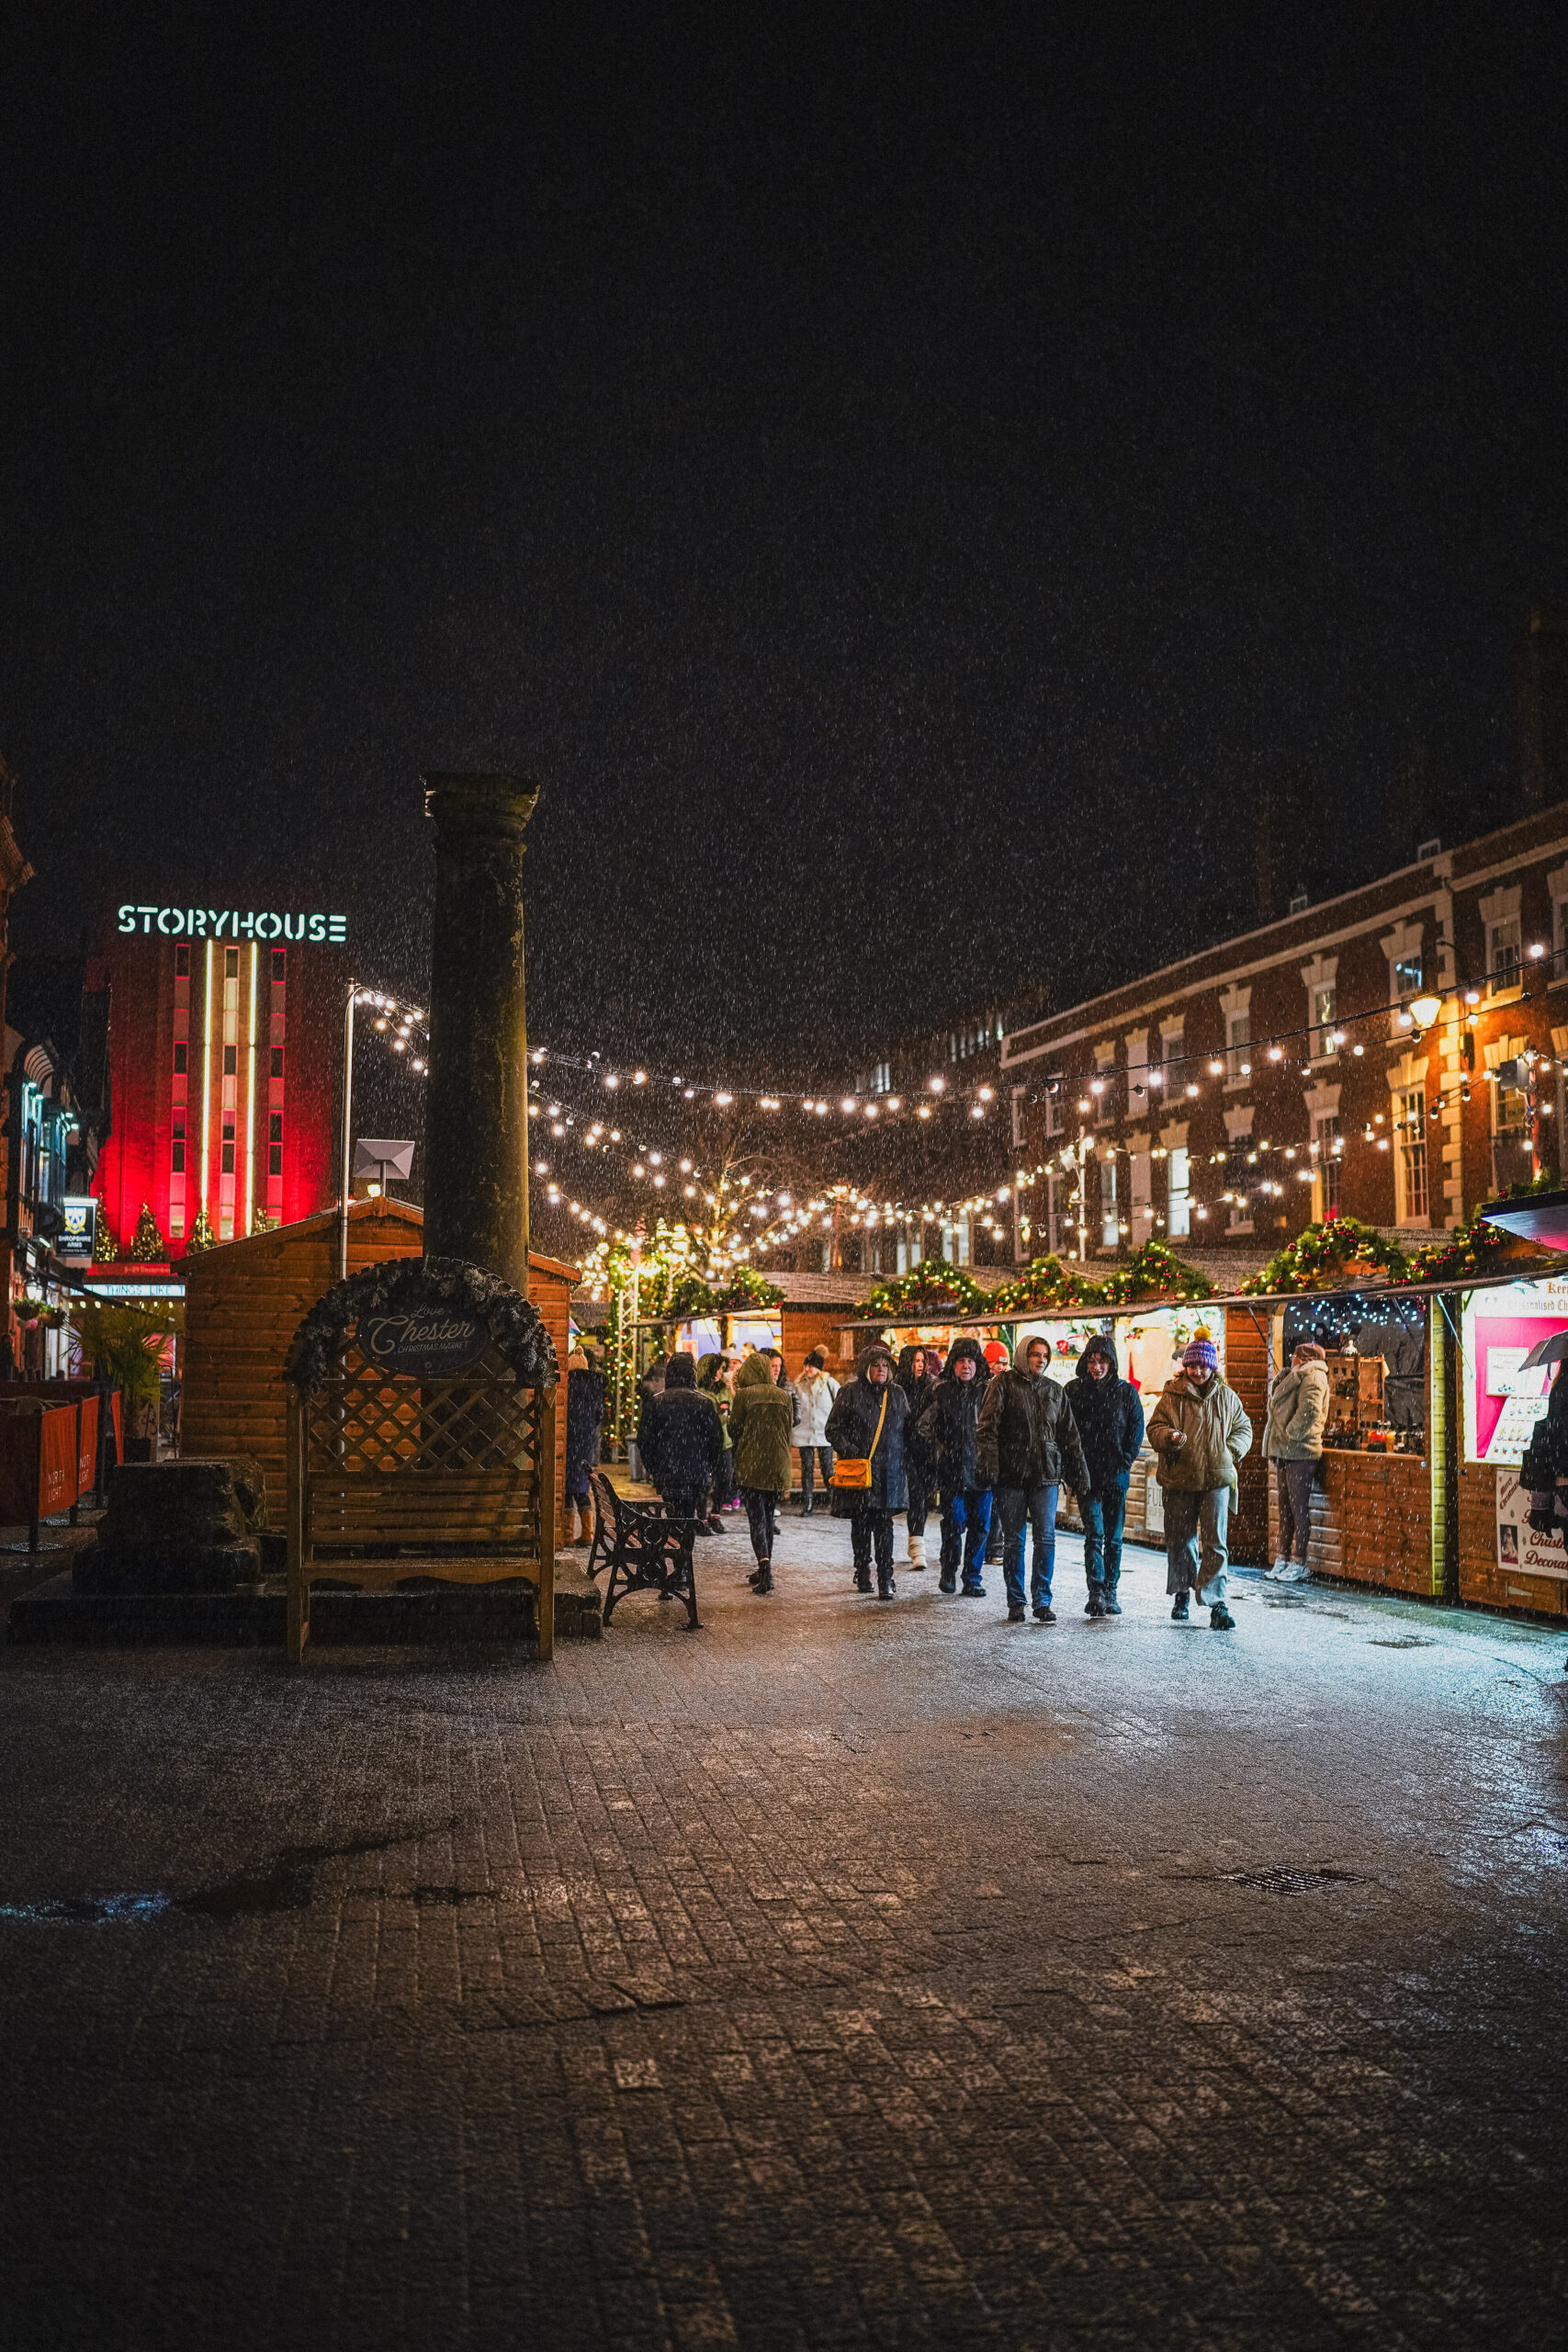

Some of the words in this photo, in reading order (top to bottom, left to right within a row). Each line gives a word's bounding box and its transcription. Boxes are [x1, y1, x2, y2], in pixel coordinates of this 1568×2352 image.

[118, 905, 346, 942] STORYHOUSE
[106, 1285, 142, 1295] THINGS
[149, 1285, 169, 1295] LIKE
[411, 1303, 445, 1318] Love
[368, 1315, 476, 1354] Chester
[397, 1342, 438, 1354] CHRISTMAS
[440, 1340, 469, 1351] MARKET
